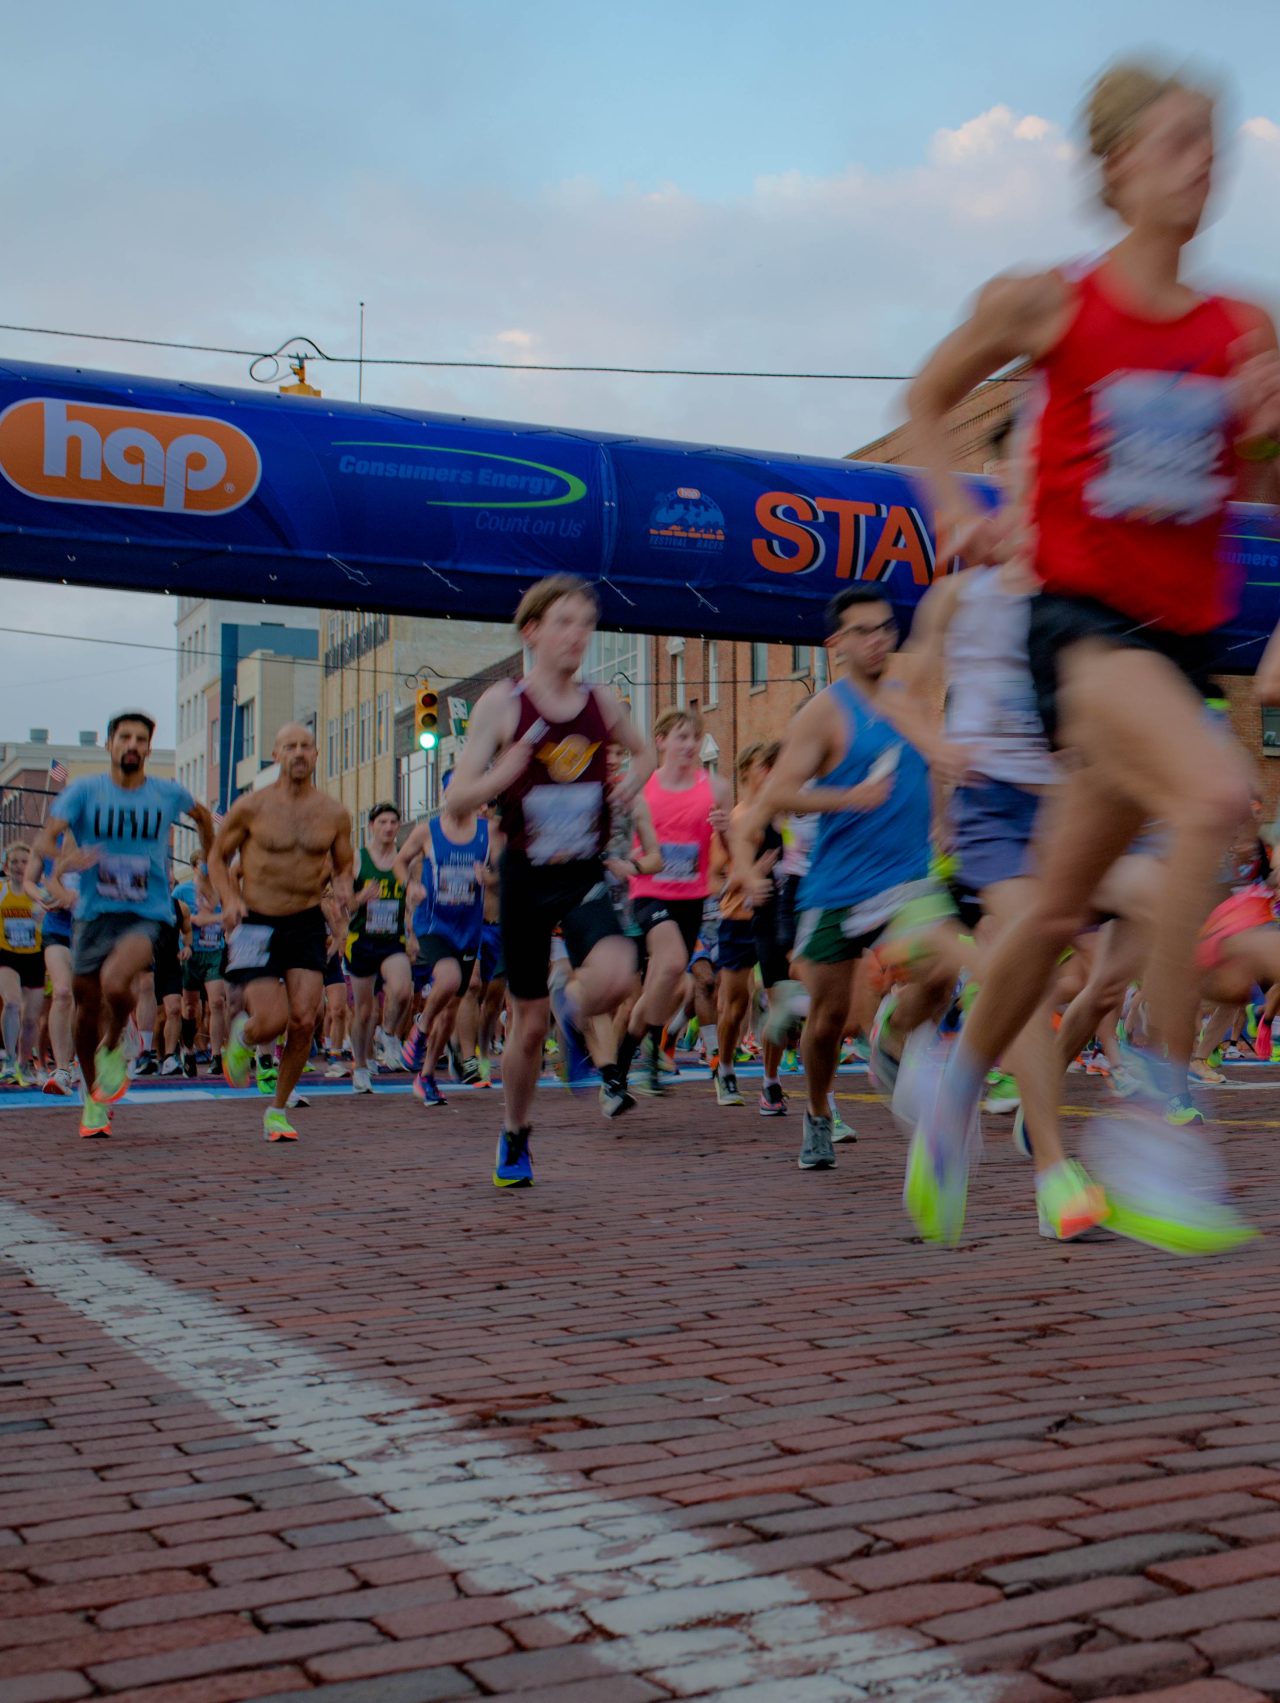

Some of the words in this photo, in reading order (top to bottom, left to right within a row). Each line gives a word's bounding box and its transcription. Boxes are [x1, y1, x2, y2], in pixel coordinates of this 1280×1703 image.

[43, 401, 228, 509] hap
[339, 455, 473, 485] Consumers
[478, 468, 558, 496] Energy
[475, 510, 530, 534] Count
[531, 519, 556, 536] on
